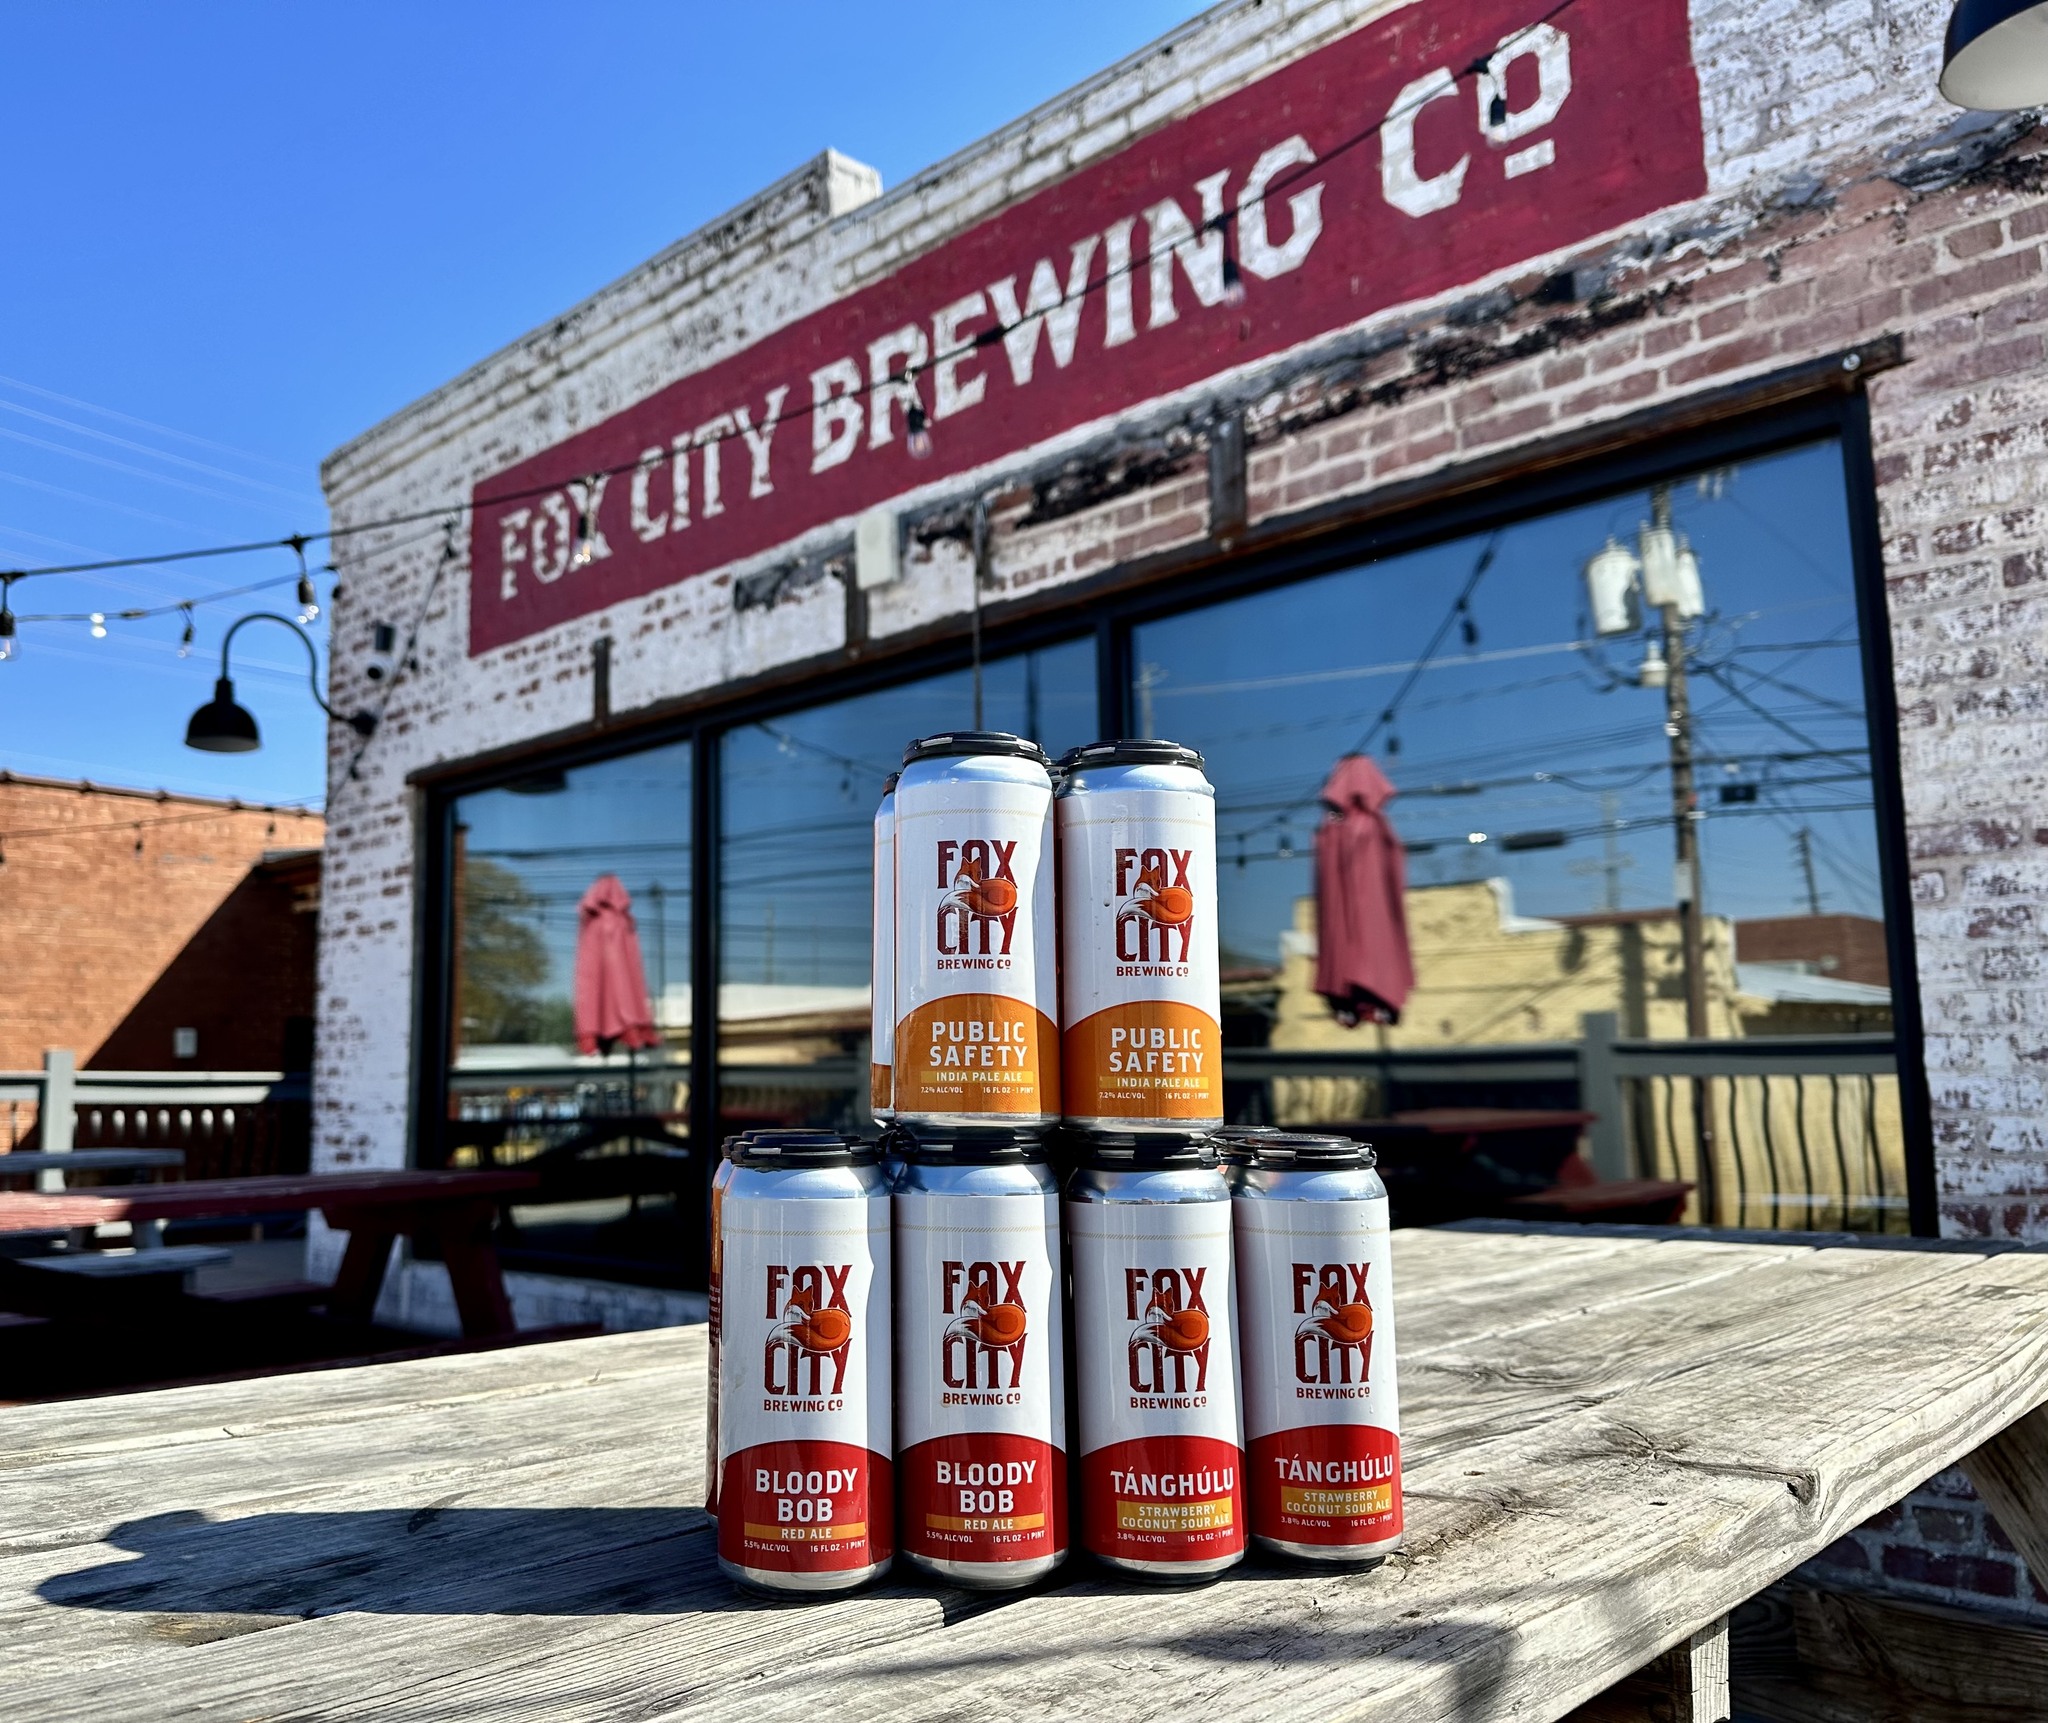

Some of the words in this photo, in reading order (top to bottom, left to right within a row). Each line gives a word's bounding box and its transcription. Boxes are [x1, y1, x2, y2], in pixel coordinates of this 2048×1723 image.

[499, 472, 614, 601] FOX
[630, 384, 791, 544] CITY
[810, 133, 1325, 475] BREWING
[937, 840, 1018, 889] FOX
[1115, 848, 1193, 896] FOX
[937, 907, 1019, 955] CITY
[1116, 915, 1194, 962] CITY
[937, 959, 994, 969] BREWING
[1117, 966, 1173, 976] BREWING
[932, 1022, 1025, 1042] PUBLIC
[1111, 1028, 1201, 1049] PUBLIC
[930, 1046, 1028, 1066] SAFETY
[1110, 1052, 1204, 1072] SAFETY
[936, 1072, 968, 1081] INDIA
[972, 1072, 1000, 1081] PALE
[1004, 1072, 1022, 1081] ALE
[1117, 1078, 1150, 1087] INDIA
[1154, 1078, 1180, 1087] PALE
[1184, 1078, 1200, 1087] ALE
[766, 1265, 853, 1319] FOX
[942, 1261, 1027, 1314] FOX
[1125, 1267, 1210, 1320] FOX
[1292, 1262, 1373, 1313] FOX
[764, 1338, 853, 1395] CITY
[943, 1333, 1028, 1389] CITY
[1128, 1338, 1211, 1393] CITY
[1295, 1330, 1374, 1384] CITY
[943, 1393, 1003, 1405] BREWING
[1131, 1397, 1190, 1409] BREWING
[1297, 1388, 1355, 1399] BREWING
[764, 1400, 824, 1412] BREWING
[937, 1460, 1036, 1486] BLOODY
[1274, 1453, 1393, 1483] TÁNGHÚLU
[756, 1468, 858, 1494] BLOODY
[1110, 1465, 1234, 1496] TÁNGHÚLU
[960, 1490, 1013, 1513] BOB
[1304, 1490, 1378, 1502] STRAWBERRY
[778, 1499, 833, 1522] BOB
[1139, 1504, 1216, 1517] STRAWBERRY
[1287, 1502, 1340, 1514] COCONUT
[1345, 1503, 1372, 1514] SOUR
[1376, 1499, 1389, 1510] ALE
[964, 1520, 987, 1530] RED
[993, 1519, 1013, 1529] ALE
[1122, 1517, 1177, 1529] COCONUT
[1182, 1518, 1211, 1529] SOUR
[1214, 1514, 1229, 1526] ALE
[1281, 1516, 1300, 1525] 3.8%
[1301, 1519, 1330, 1527] ALC/VOL
[1383, 1513, 1393, 1522] PINT
[782, 1529, 805, 1539] RED
[810, 1528, 832, 1538] ALE
[926, 1531, 942, 1540] 5.5%
[944, 1534, 973, 1542] ALC/VOL
[1013, 1534, 1021, 1542] OZ
[1031, 1530, 1045, 1539] PINT
[1117, 1532, 1135, 1541] 3.8%
[1137, 1535, 1166, 1543] ALC/VOL
[1206, 1533, 1214, 1541] OZ
[1222, 1528, 1233, 1538] PINT
[744, 1540, 760, 1550] 5.5%
[851, 1540, 865, 1549] PINT
